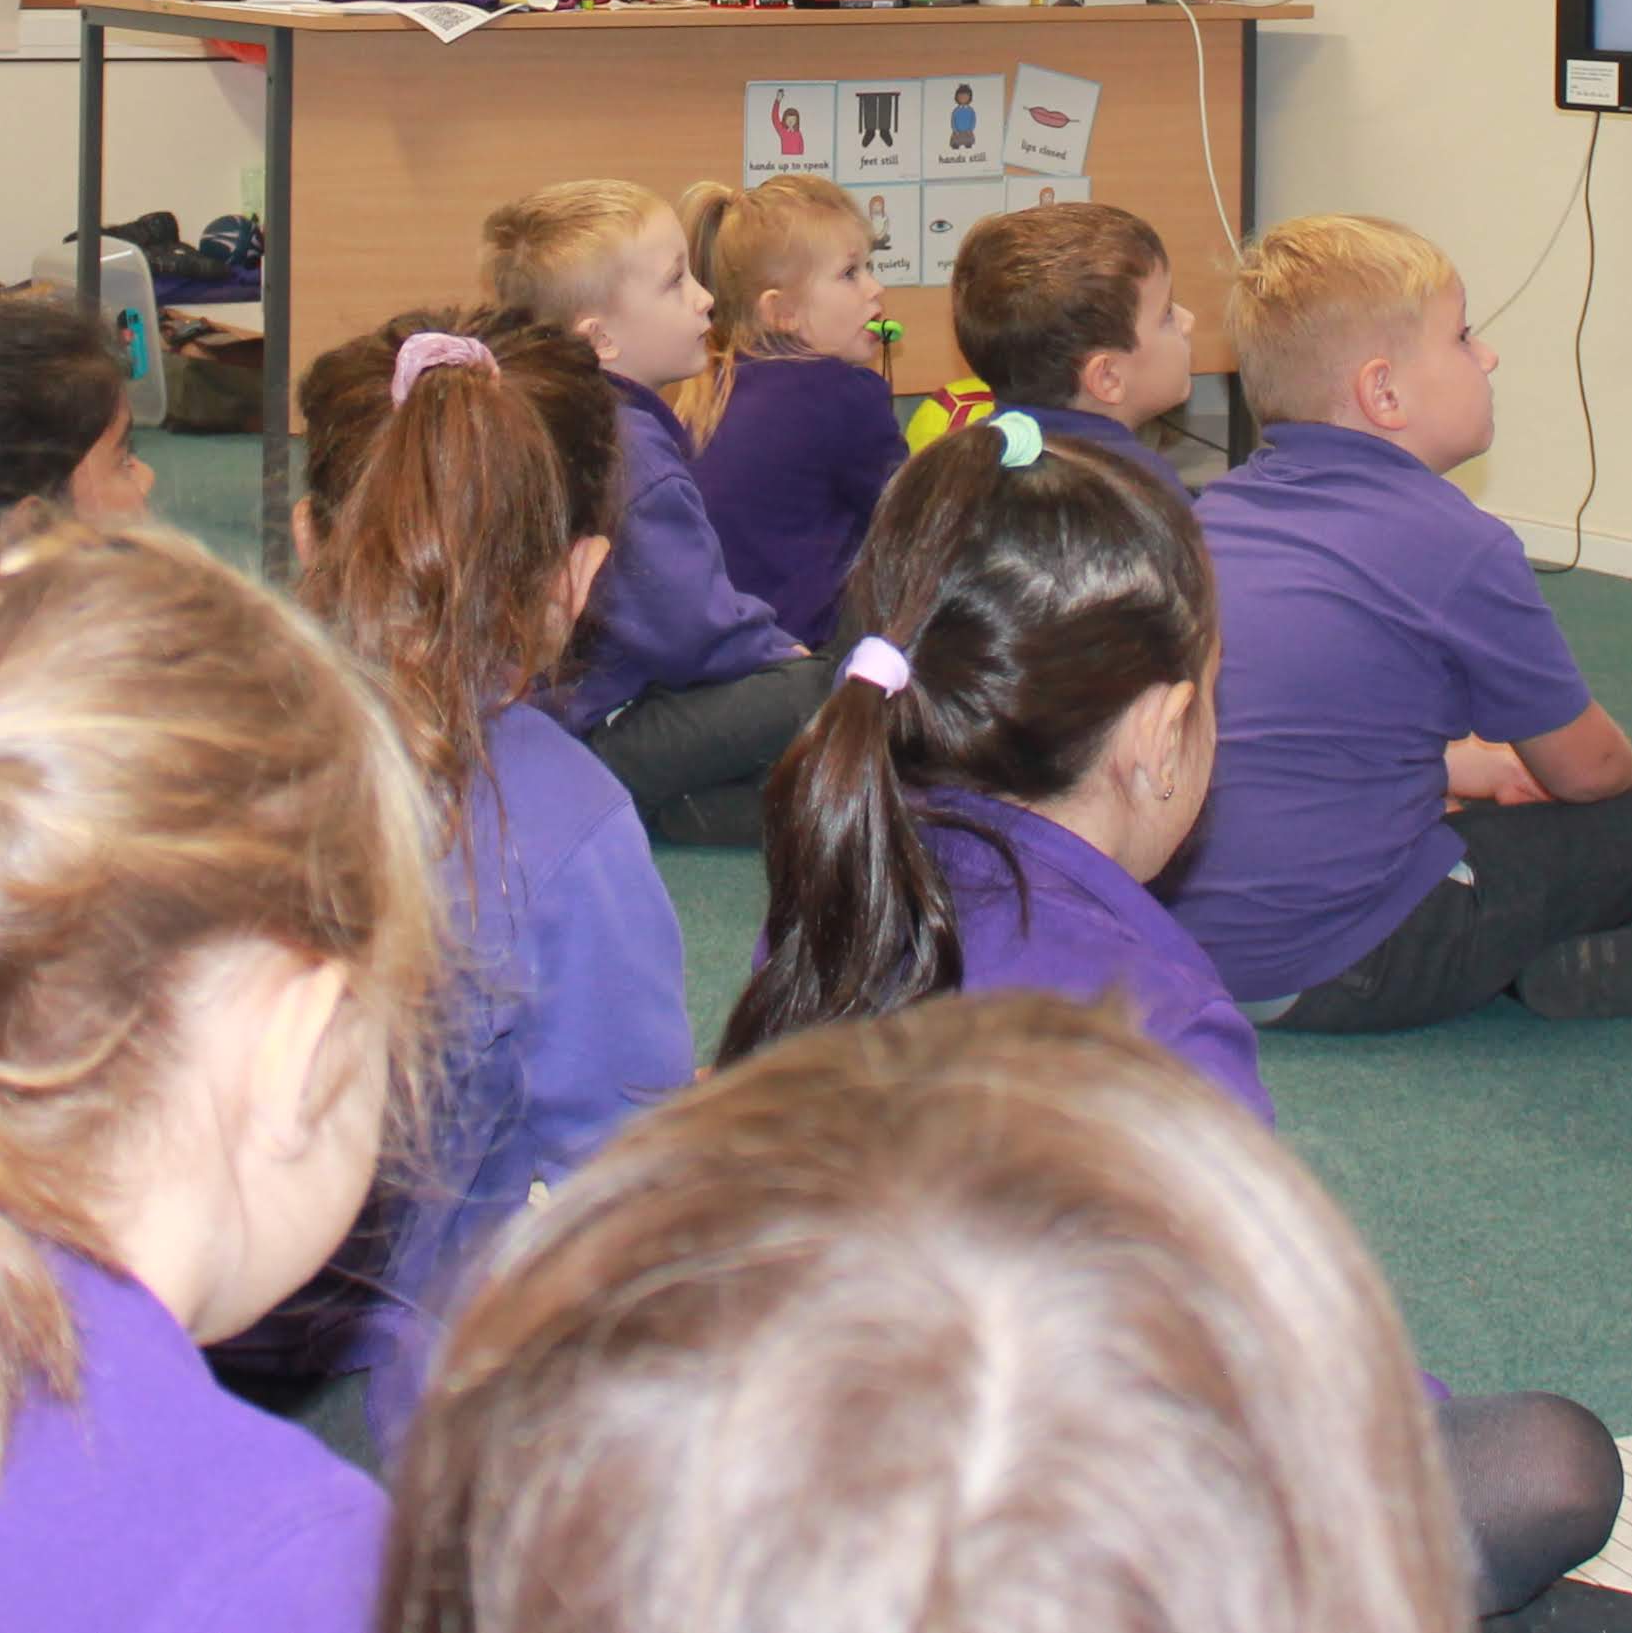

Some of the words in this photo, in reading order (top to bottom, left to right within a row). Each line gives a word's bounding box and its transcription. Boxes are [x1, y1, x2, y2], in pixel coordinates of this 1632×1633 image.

[938, 153, 966, 164] hands
[969, 152, 986, 164] still
[1020, 141, 1037, 155] lips
[1038, 144, 1068, 161] closed
[859, 155, 879, 169] feet
[881, 155, 899, 166] still
